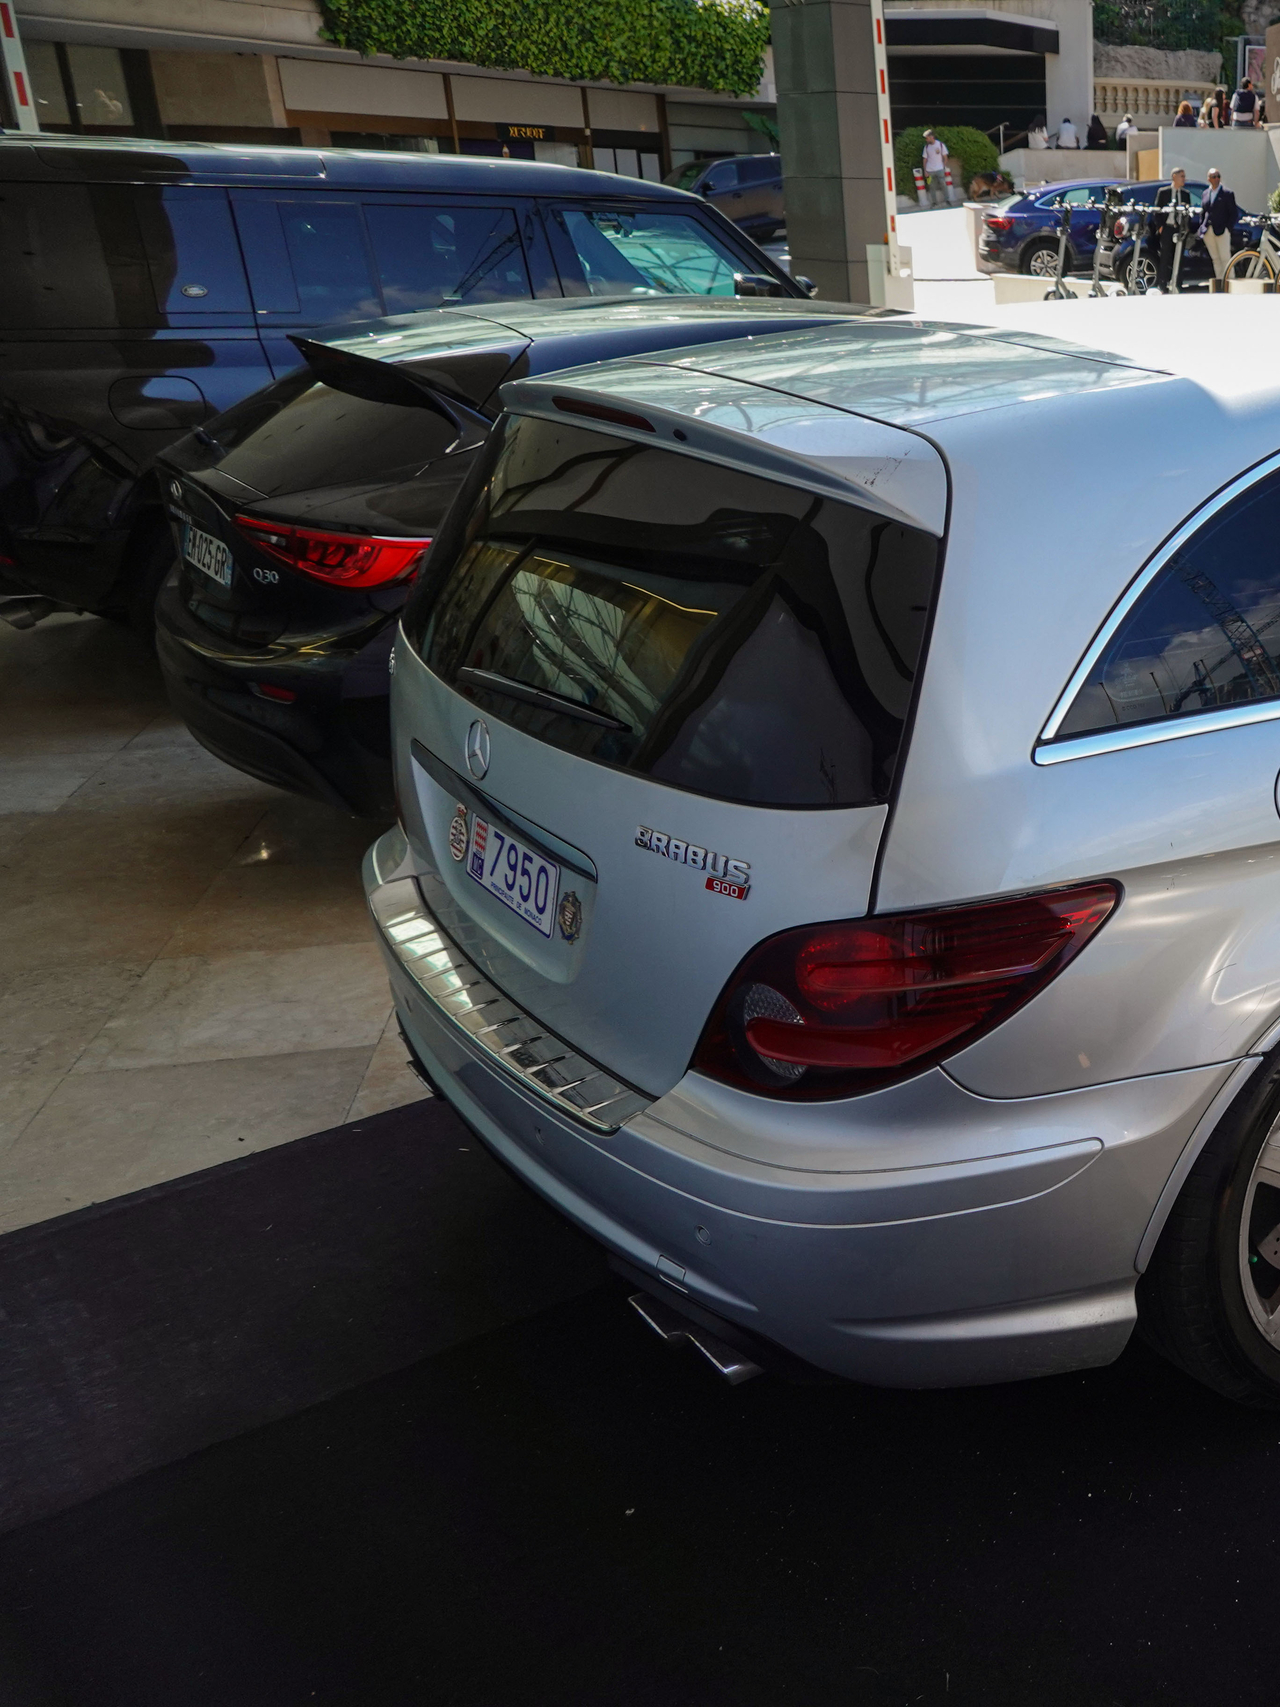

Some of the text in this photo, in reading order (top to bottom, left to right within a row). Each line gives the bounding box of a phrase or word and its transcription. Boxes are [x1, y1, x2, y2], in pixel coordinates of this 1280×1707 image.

[253, 567, 279, 584] Q30
[635, 825, 751, 885] BRABUS
[489, 830, 550, 916] 7950
[712, 880, 739, 898] 900
[524, 907, 543, 926] MONACO
